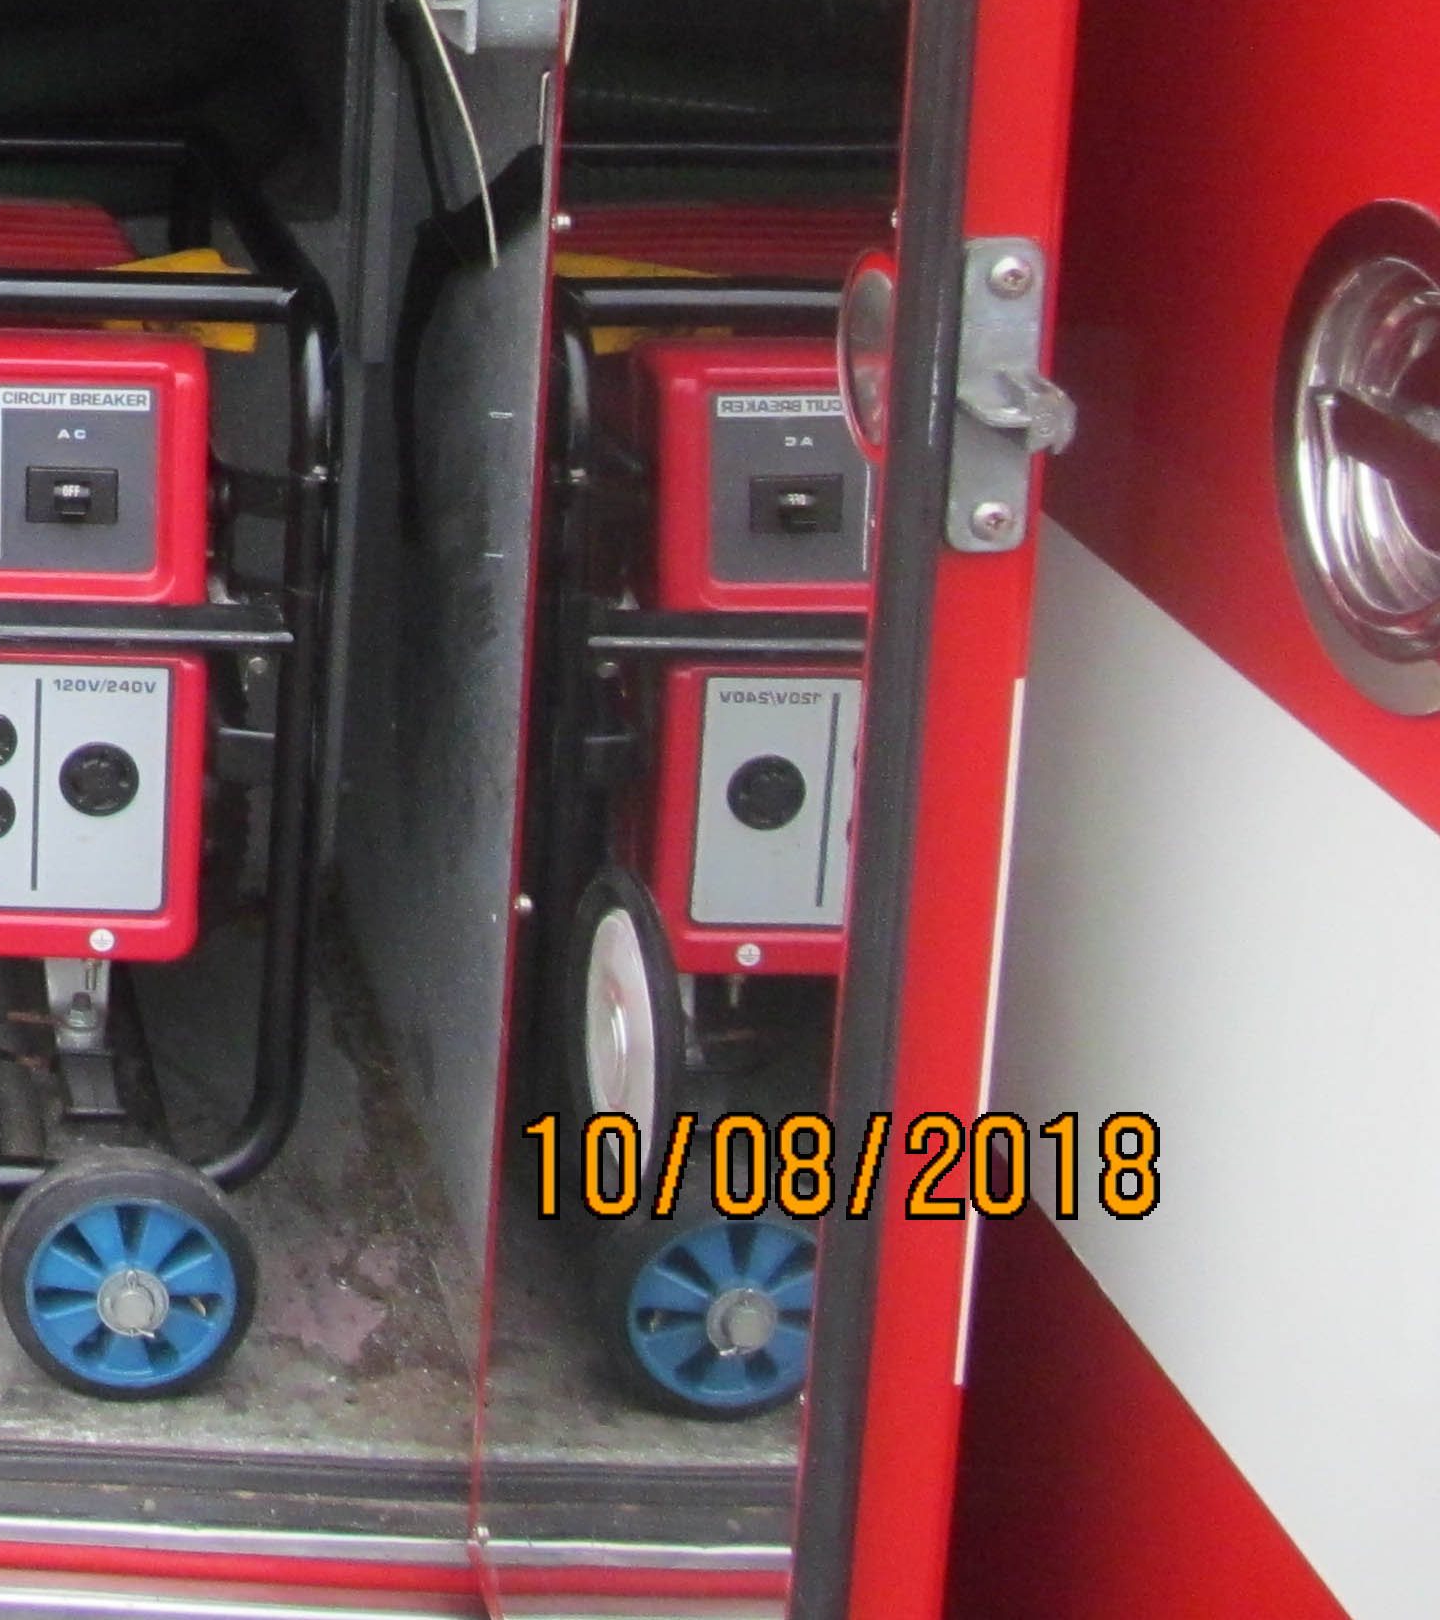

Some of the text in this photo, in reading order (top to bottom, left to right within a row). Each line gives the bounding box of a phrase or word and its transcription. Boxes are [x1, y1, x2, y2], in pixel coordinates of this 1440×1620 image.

[2, 391, 147, 406] CIRCUIT BREAKER
[61, 484, 80, 497] OFF
[53, 679, 157, 694] 120V/240V
